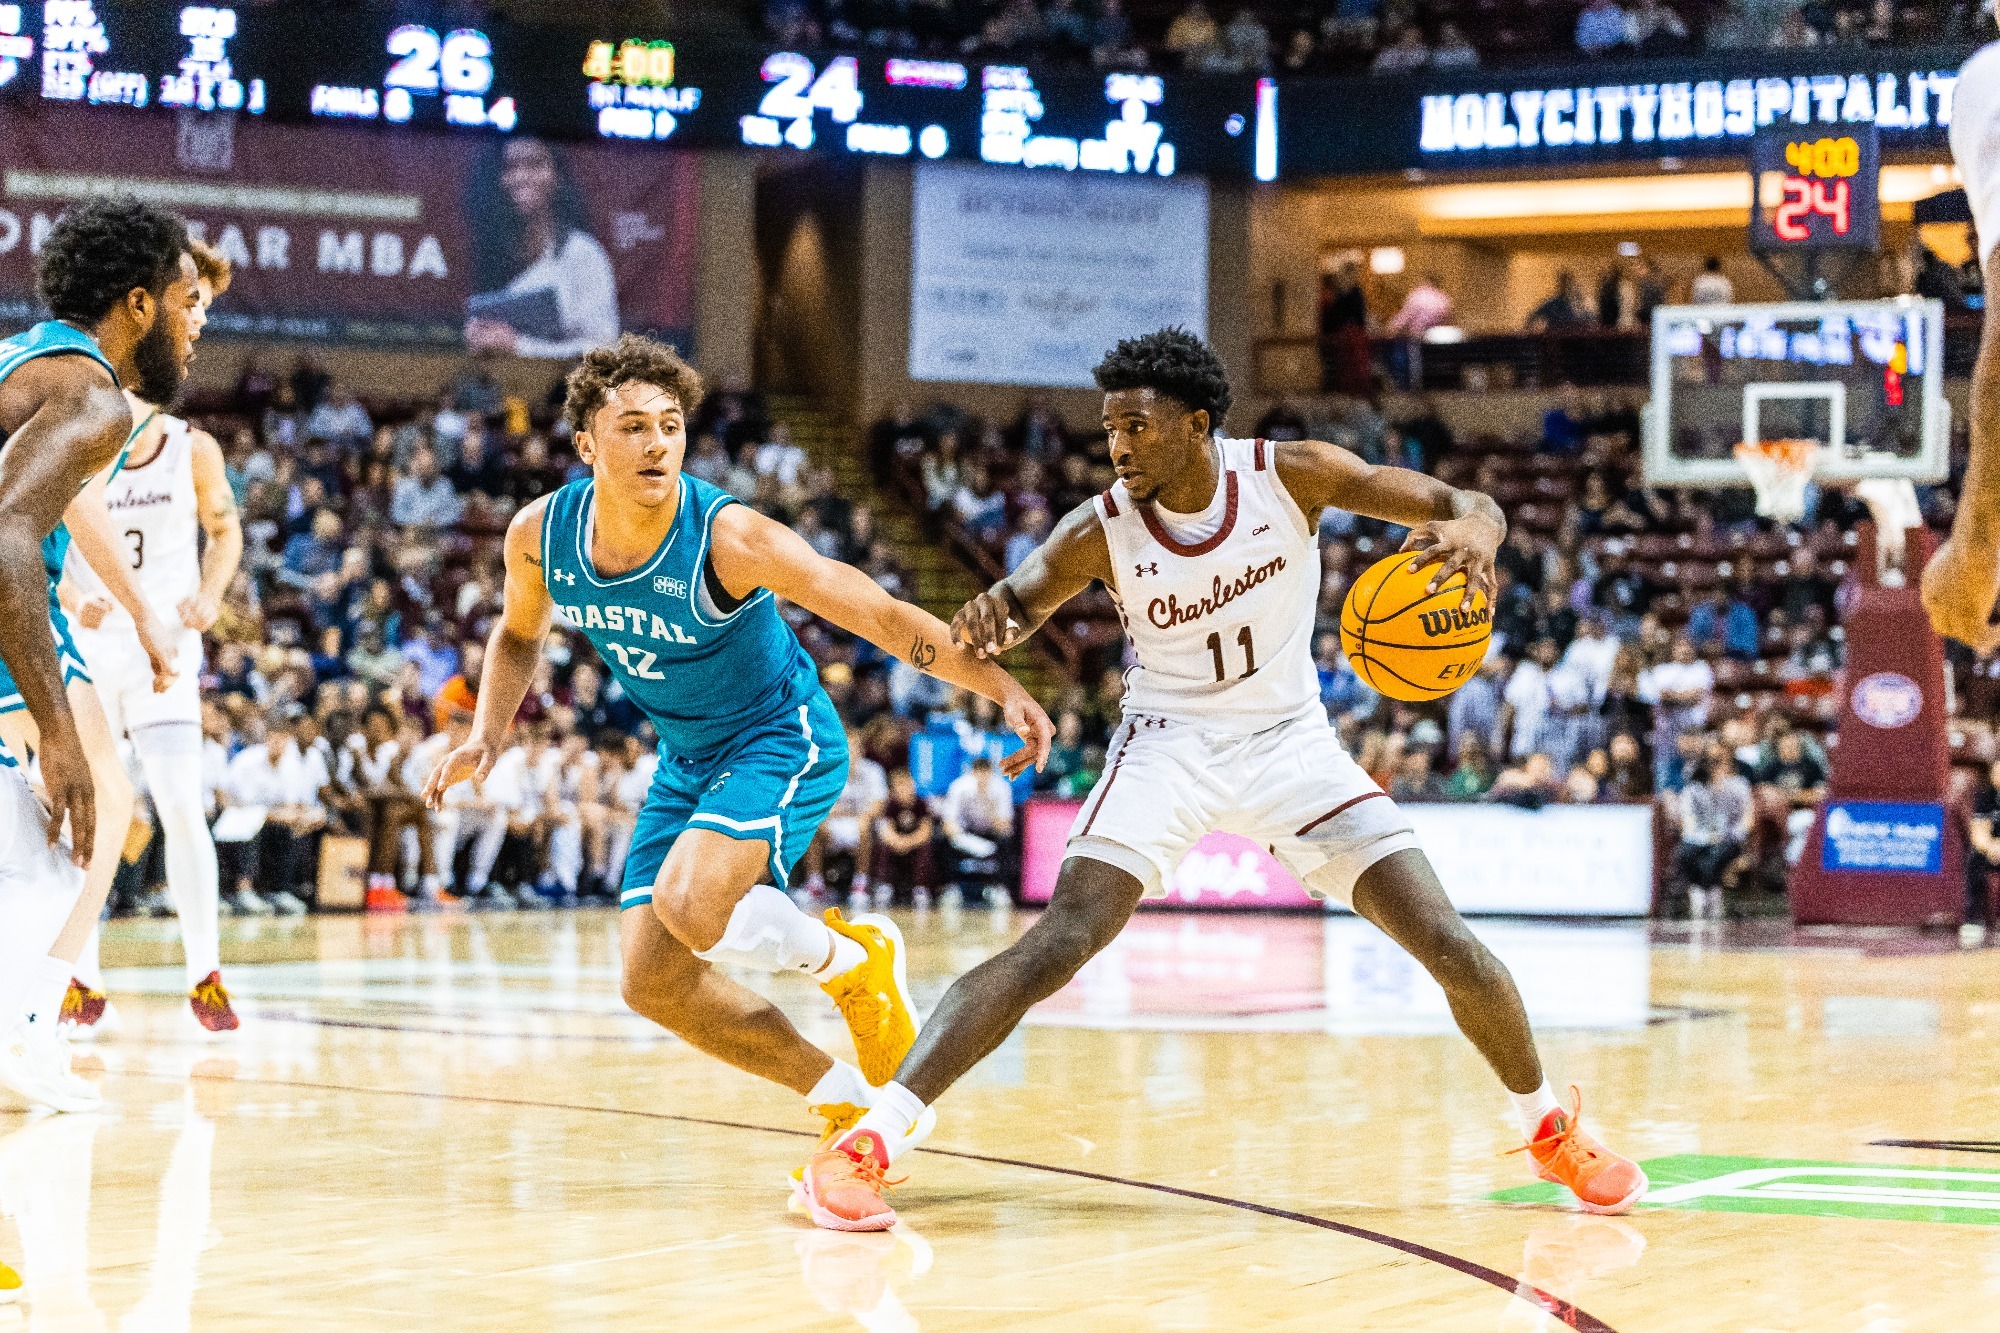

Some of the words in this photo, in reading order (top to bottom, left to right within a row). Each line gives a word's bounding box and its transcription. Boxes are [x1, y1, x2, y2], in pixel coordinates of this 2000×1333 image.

[384, 25, 493, 94] 26
[759, 52, 863, 123] 24
[1420, 70, 1960, 152] HOLYCITYHOSPITALIT
[1774, 176, 1850, 240] 24
[317, 228, 449, 279] MBA
[124, 528, 144, 569] 3
[1252, 524, 1270, 536] CAA
[653, 575, 687, 599] SBC
[1147, 556, 1287, 629] Charleston
[559, 604, 698, 645] OASTAL
[606, 642, 666, 680] 12
[1206, 625, 1259, 683] 11
